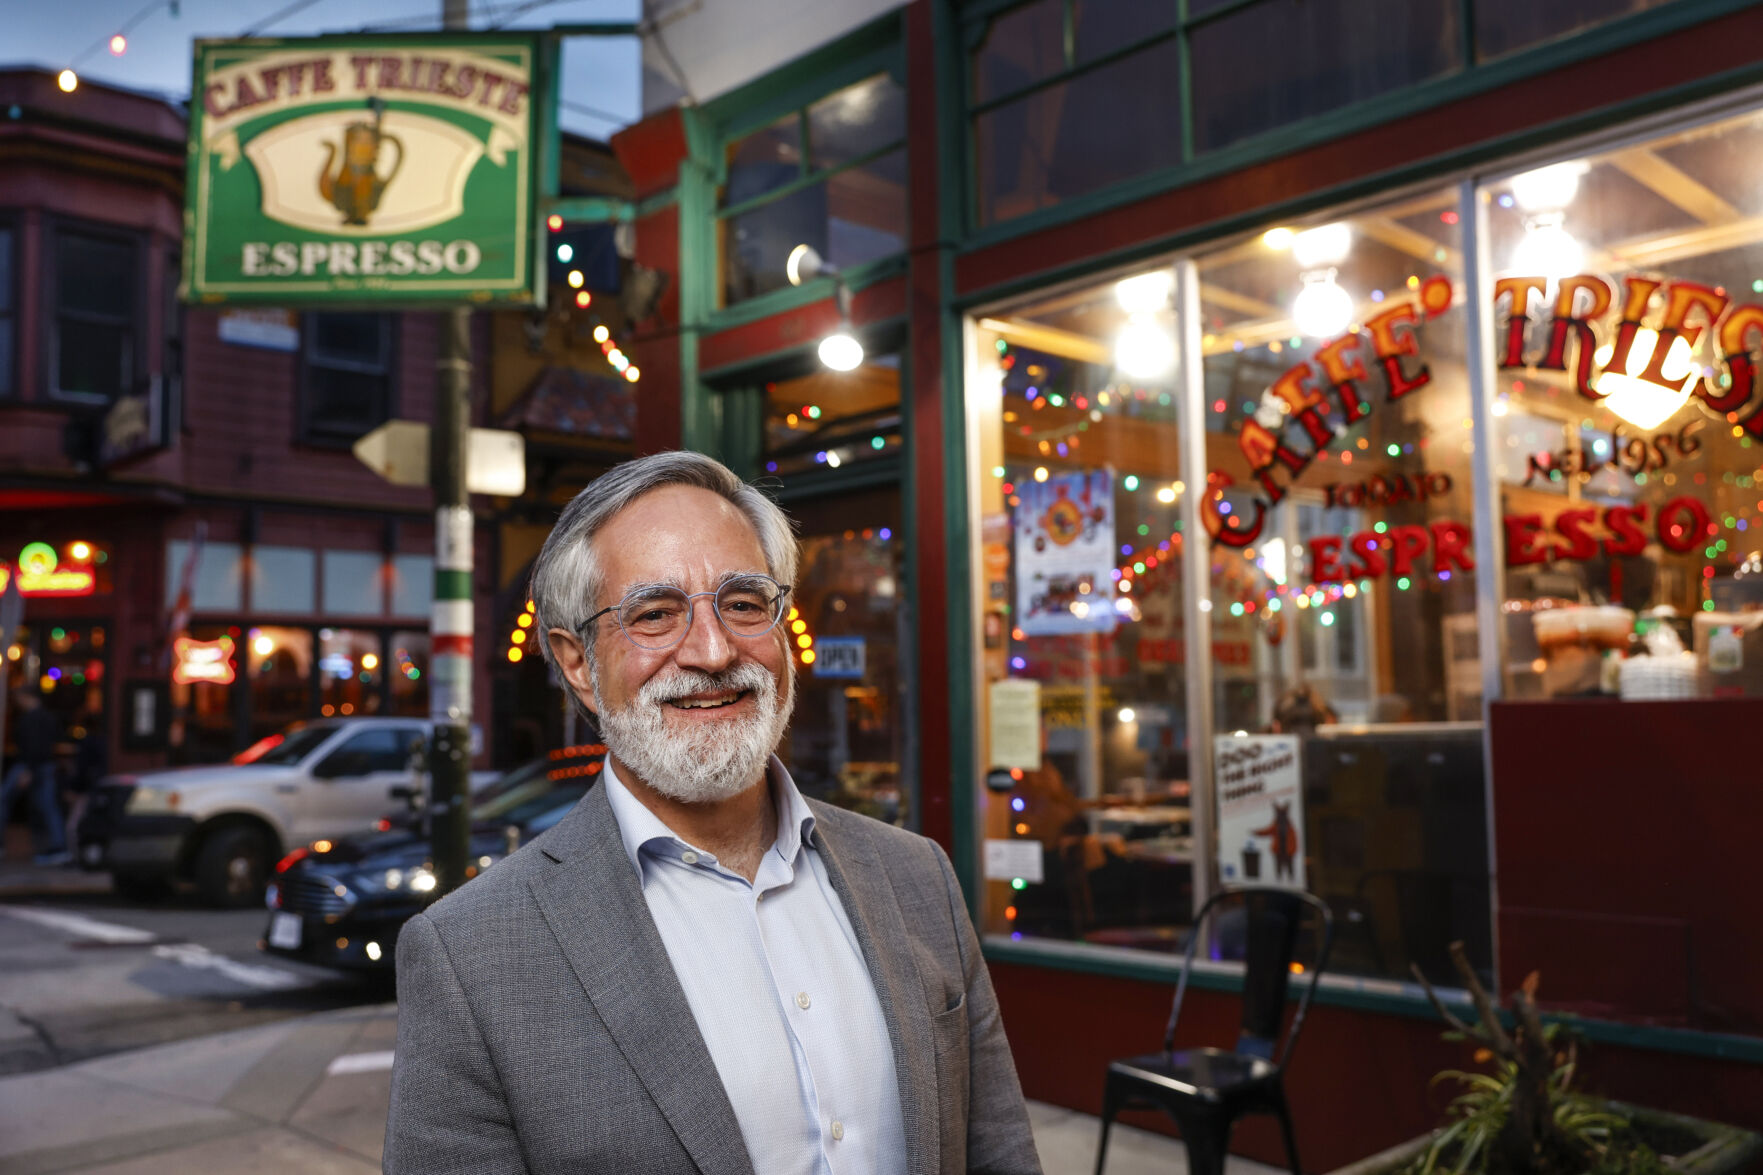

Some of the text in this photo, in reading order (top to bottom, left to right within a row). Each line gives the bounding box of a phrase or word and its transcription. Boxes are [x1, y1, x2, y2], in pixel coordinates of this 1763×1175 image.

[204, 55, 530, 119] CAFFE TRIESTE
[241, 240, 481, 277] ESPRESSO
[1494, 275, 1763, 446] TRIES
[1308, 496, 1711, 584] ESPRESSO
[819, 646, 859, 669] OPEN
